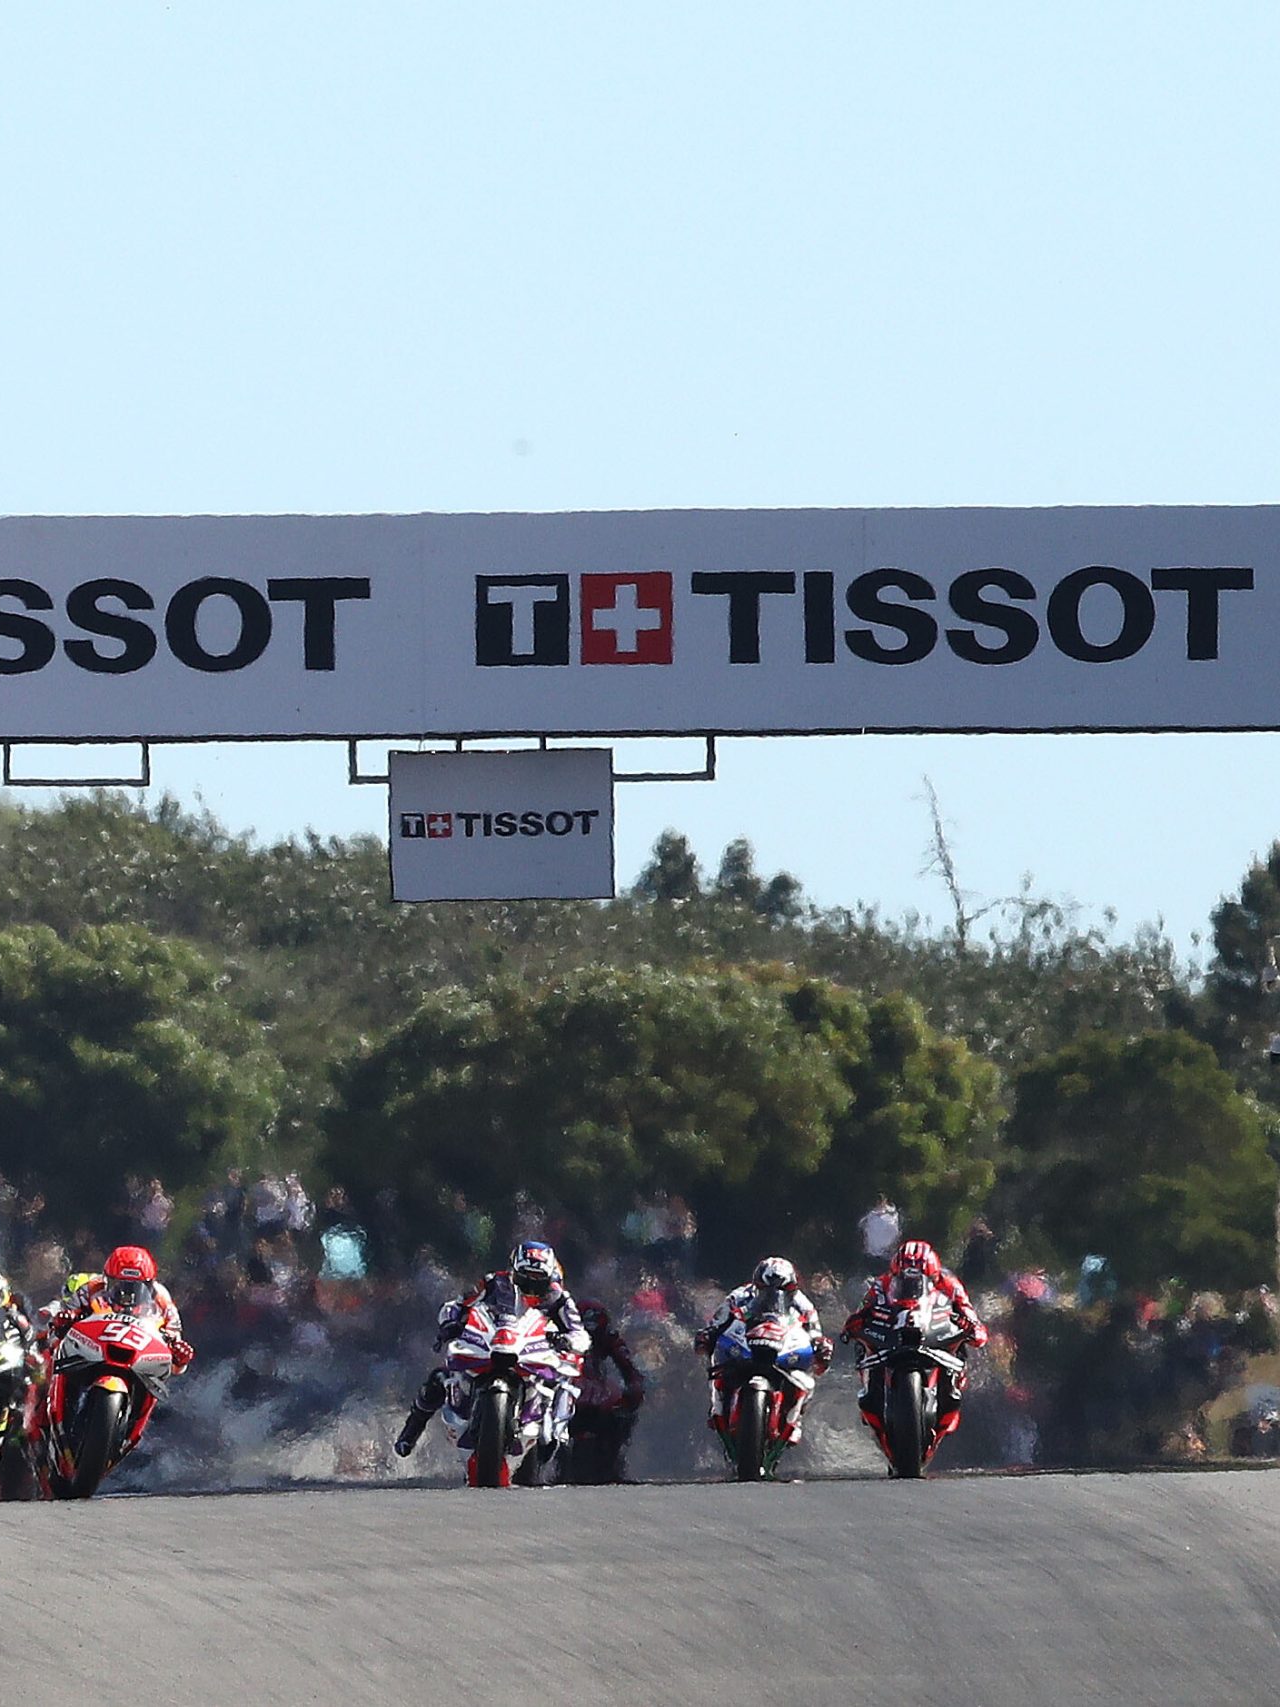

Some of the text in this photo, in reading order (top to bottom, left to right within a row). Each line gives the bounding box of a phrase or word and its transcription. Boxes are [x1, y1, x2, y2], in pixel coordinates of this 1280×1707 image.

[690, 565, 1256, 666] TISSOT
[457, 809, 600, 838] TISSOT
[98, 1323, 153, 1350] 93
